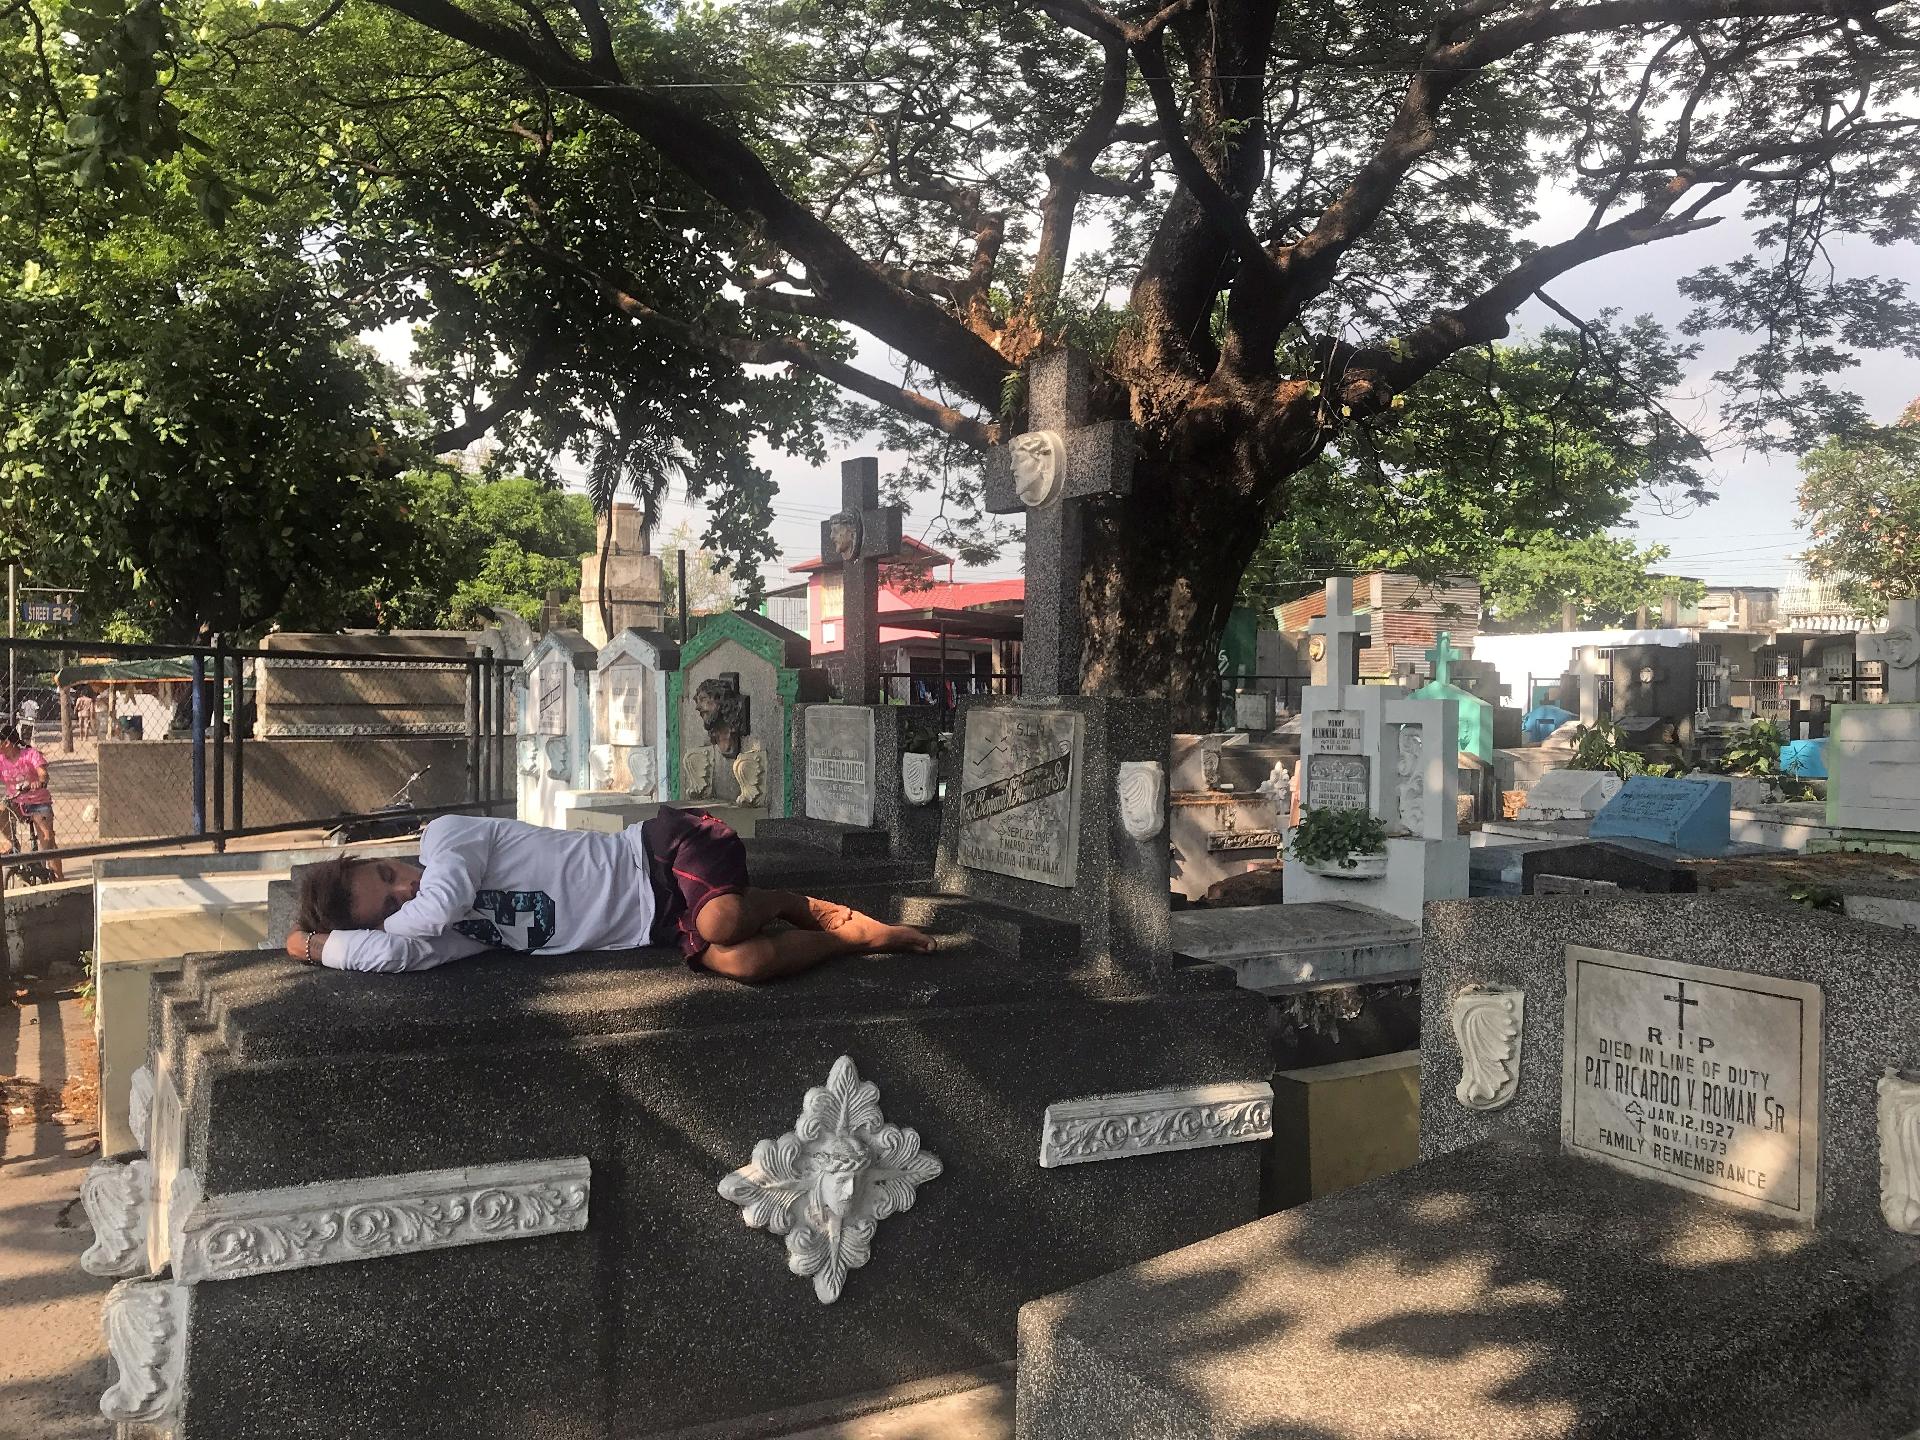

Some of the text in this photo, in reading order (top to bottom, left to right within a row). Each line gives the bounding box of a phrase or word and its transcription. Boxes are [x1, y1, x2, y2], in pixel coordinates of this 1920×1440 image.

[28, 606, 73, 622] STREET 24
[1599, 1037, 1770, 1092] DIED IN LINE OF DUTY
[1615, 1062, 1681, 1108] RICARDO
[1702, 1081, 1757, 1128] ROMAN
[1764, 1096, 1785, 1134] SR
[1599, 1127, 1767, 1190] FAMILY REMEMBRANCE
